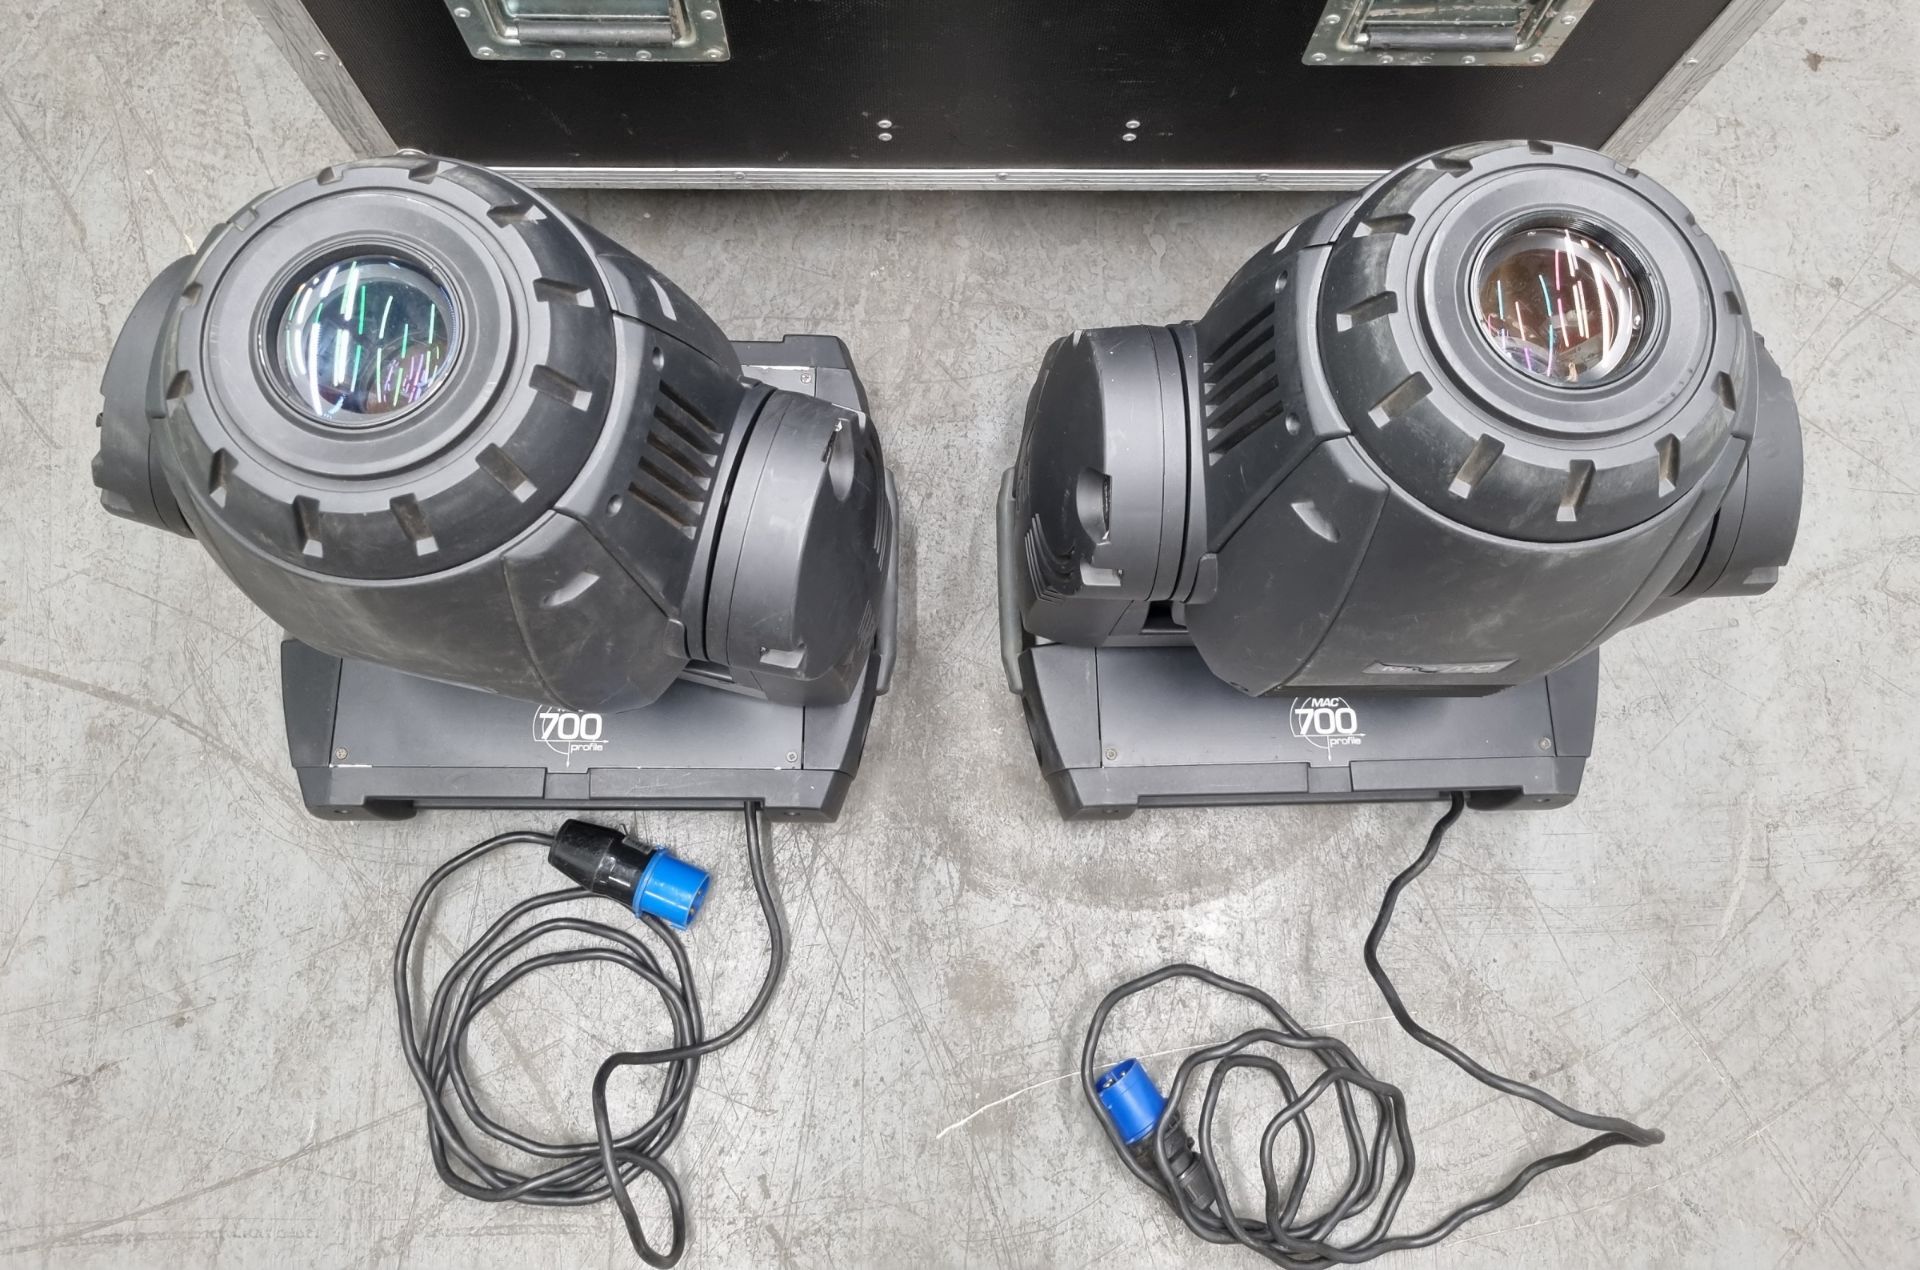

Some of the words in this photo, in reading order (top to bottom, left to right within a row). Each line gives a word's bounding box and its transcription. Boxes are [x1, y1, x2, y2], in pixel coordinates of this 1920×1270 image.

[1311, 698, 1339, 707] MAC
[539, 713, 602, 740] 700
[1295, 707, 1358, 735] 700
[1329, 736, 1361, 748] profile
[570, 743, 603, 754] profile
